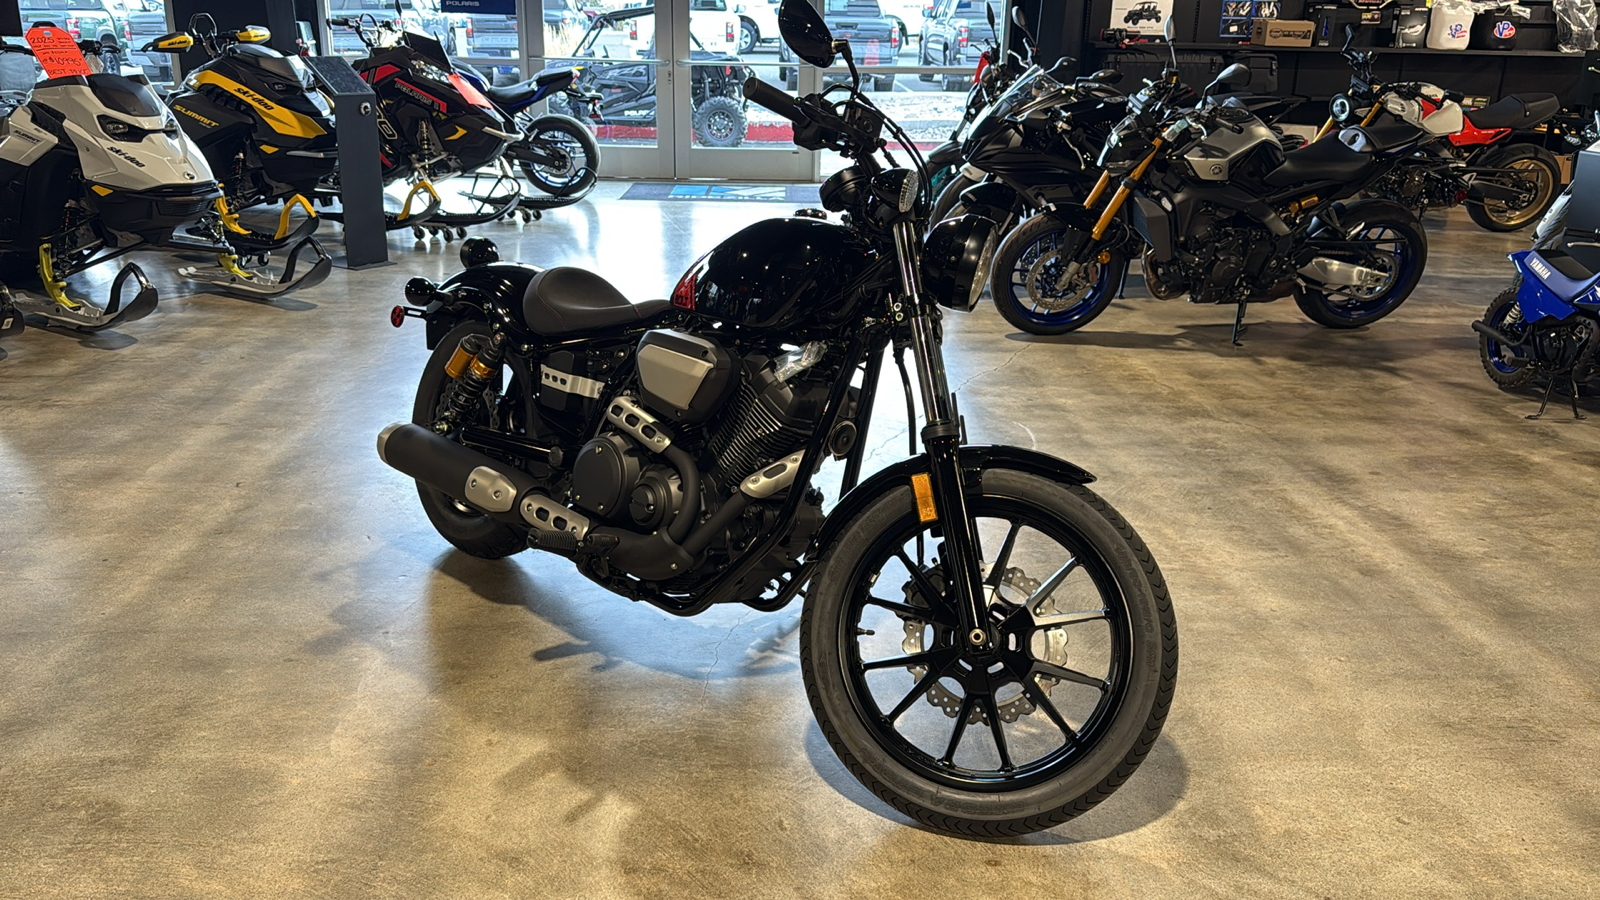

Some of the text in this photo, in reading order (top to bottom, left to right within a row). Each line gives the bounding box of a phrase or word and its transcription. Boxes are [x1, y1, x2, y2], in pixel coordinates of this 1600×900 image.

[234, 87, 275, 111] ski-doo
[394, 81, 433, 106] POLARIS
[173, 104, 220, 127] SUMMIT
[13, 130, 41, 143] SUMMIT
[106, 146, 146, 168] ski-doo
[1529, 257, 1552, 280] YAMAHA
[675, 294, 689, 307] BOLT
